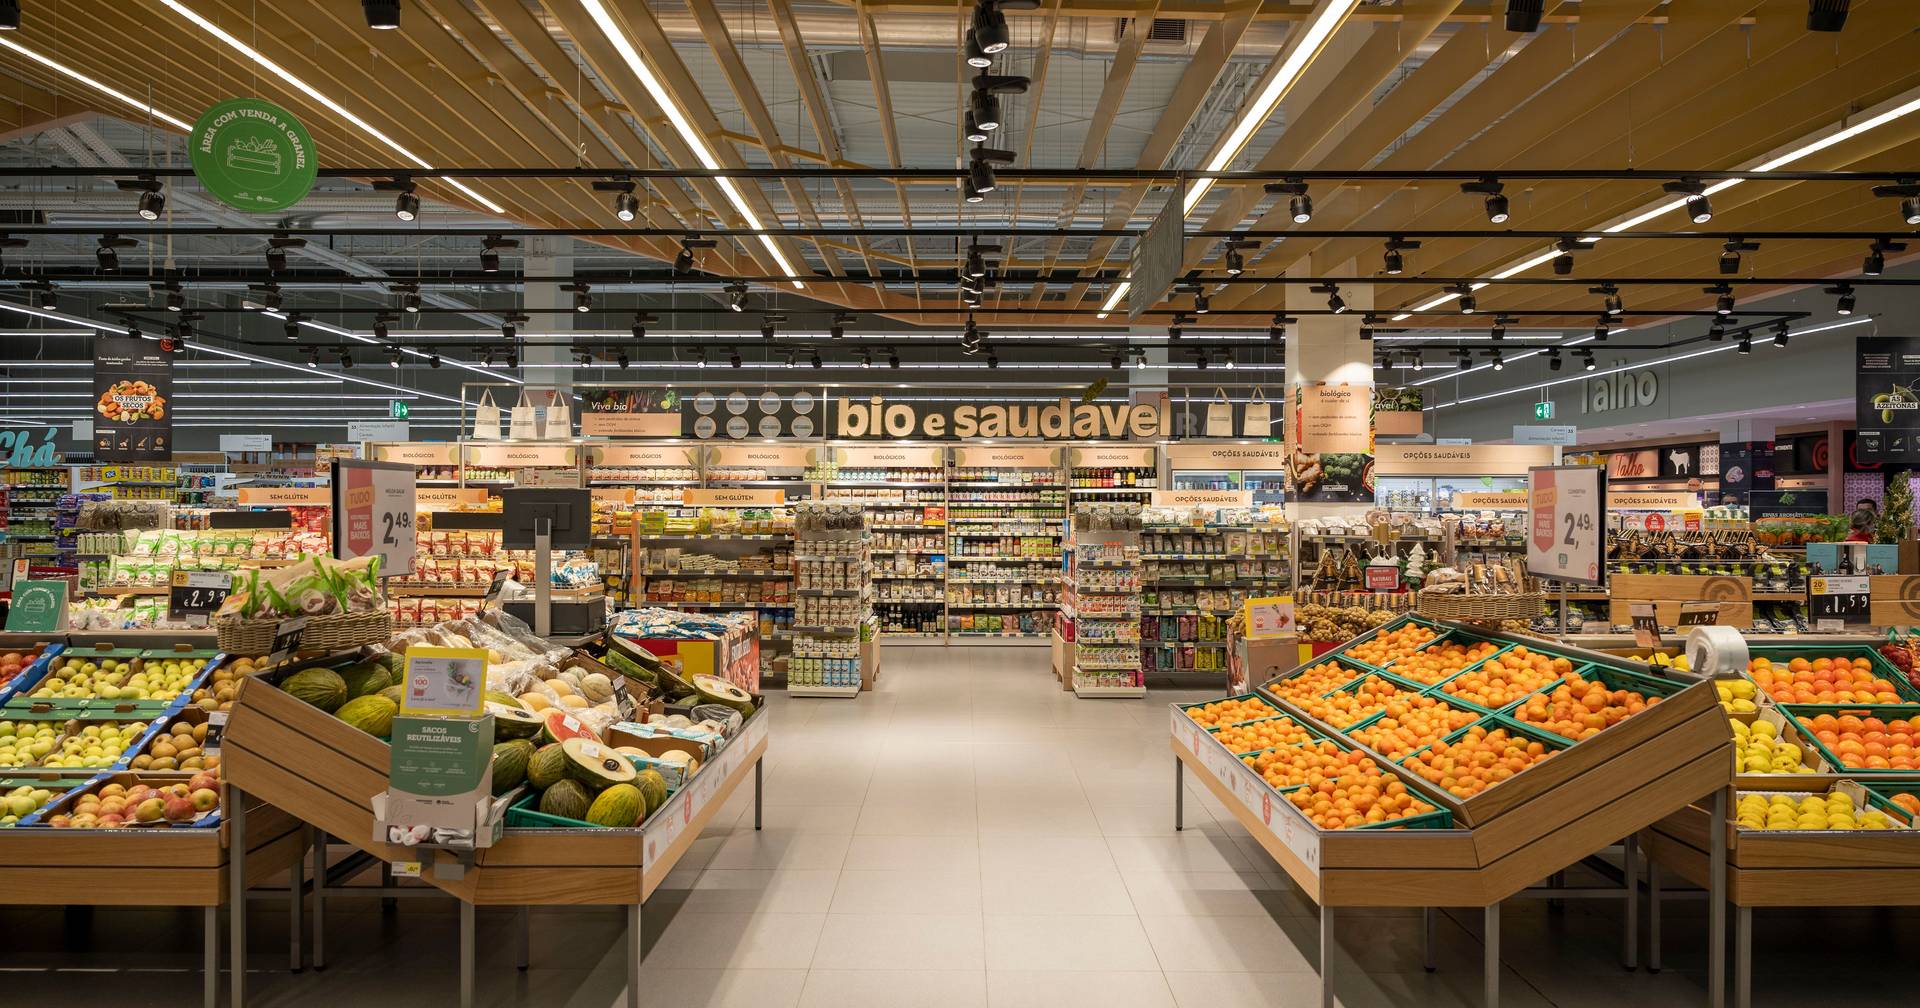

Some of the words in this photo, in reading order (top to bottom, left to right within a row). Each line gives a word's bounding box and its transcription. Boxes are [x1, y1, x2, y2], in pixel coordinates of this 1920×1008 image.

[200, 127, 216, 154] ÁREA
[214, 110, 237, 128] COM
[238, 110, 278, 124] VENDA
[278, 122, 288, 131] A
[286, 130, 305, 170] GRANEL
[1320, 390, 1351, 398] biológico
[591, 401, 610, 410] Viva
[614, 401, 627, 410] bio
[1375, 400, 1394, 409] ável
[838, 396, 916, 438] bio
[923, 411, 946, 437] e
[1212, 449, 1240, 458] OPÇÕES
[1242, 449, 1279, 458] SAUDÁVEIS
[1403, 451, 1432, 460] OPÇÕES
[1434, 450, 1470, 459] SAUDÁVEIS
[1616, 452, 1645, 477] Talho
[350, 491, 369, 505] TUDO
[1175, 495, 1201, 503] OPÇÕES
[1472, 497, 1500, 505] OPÇÕES
[1536, 492, 1553, 504] TUDO
[353, 522, 368, 530] MAIS
[407, 734, 462, 743] REUTILIZÁVEIS
